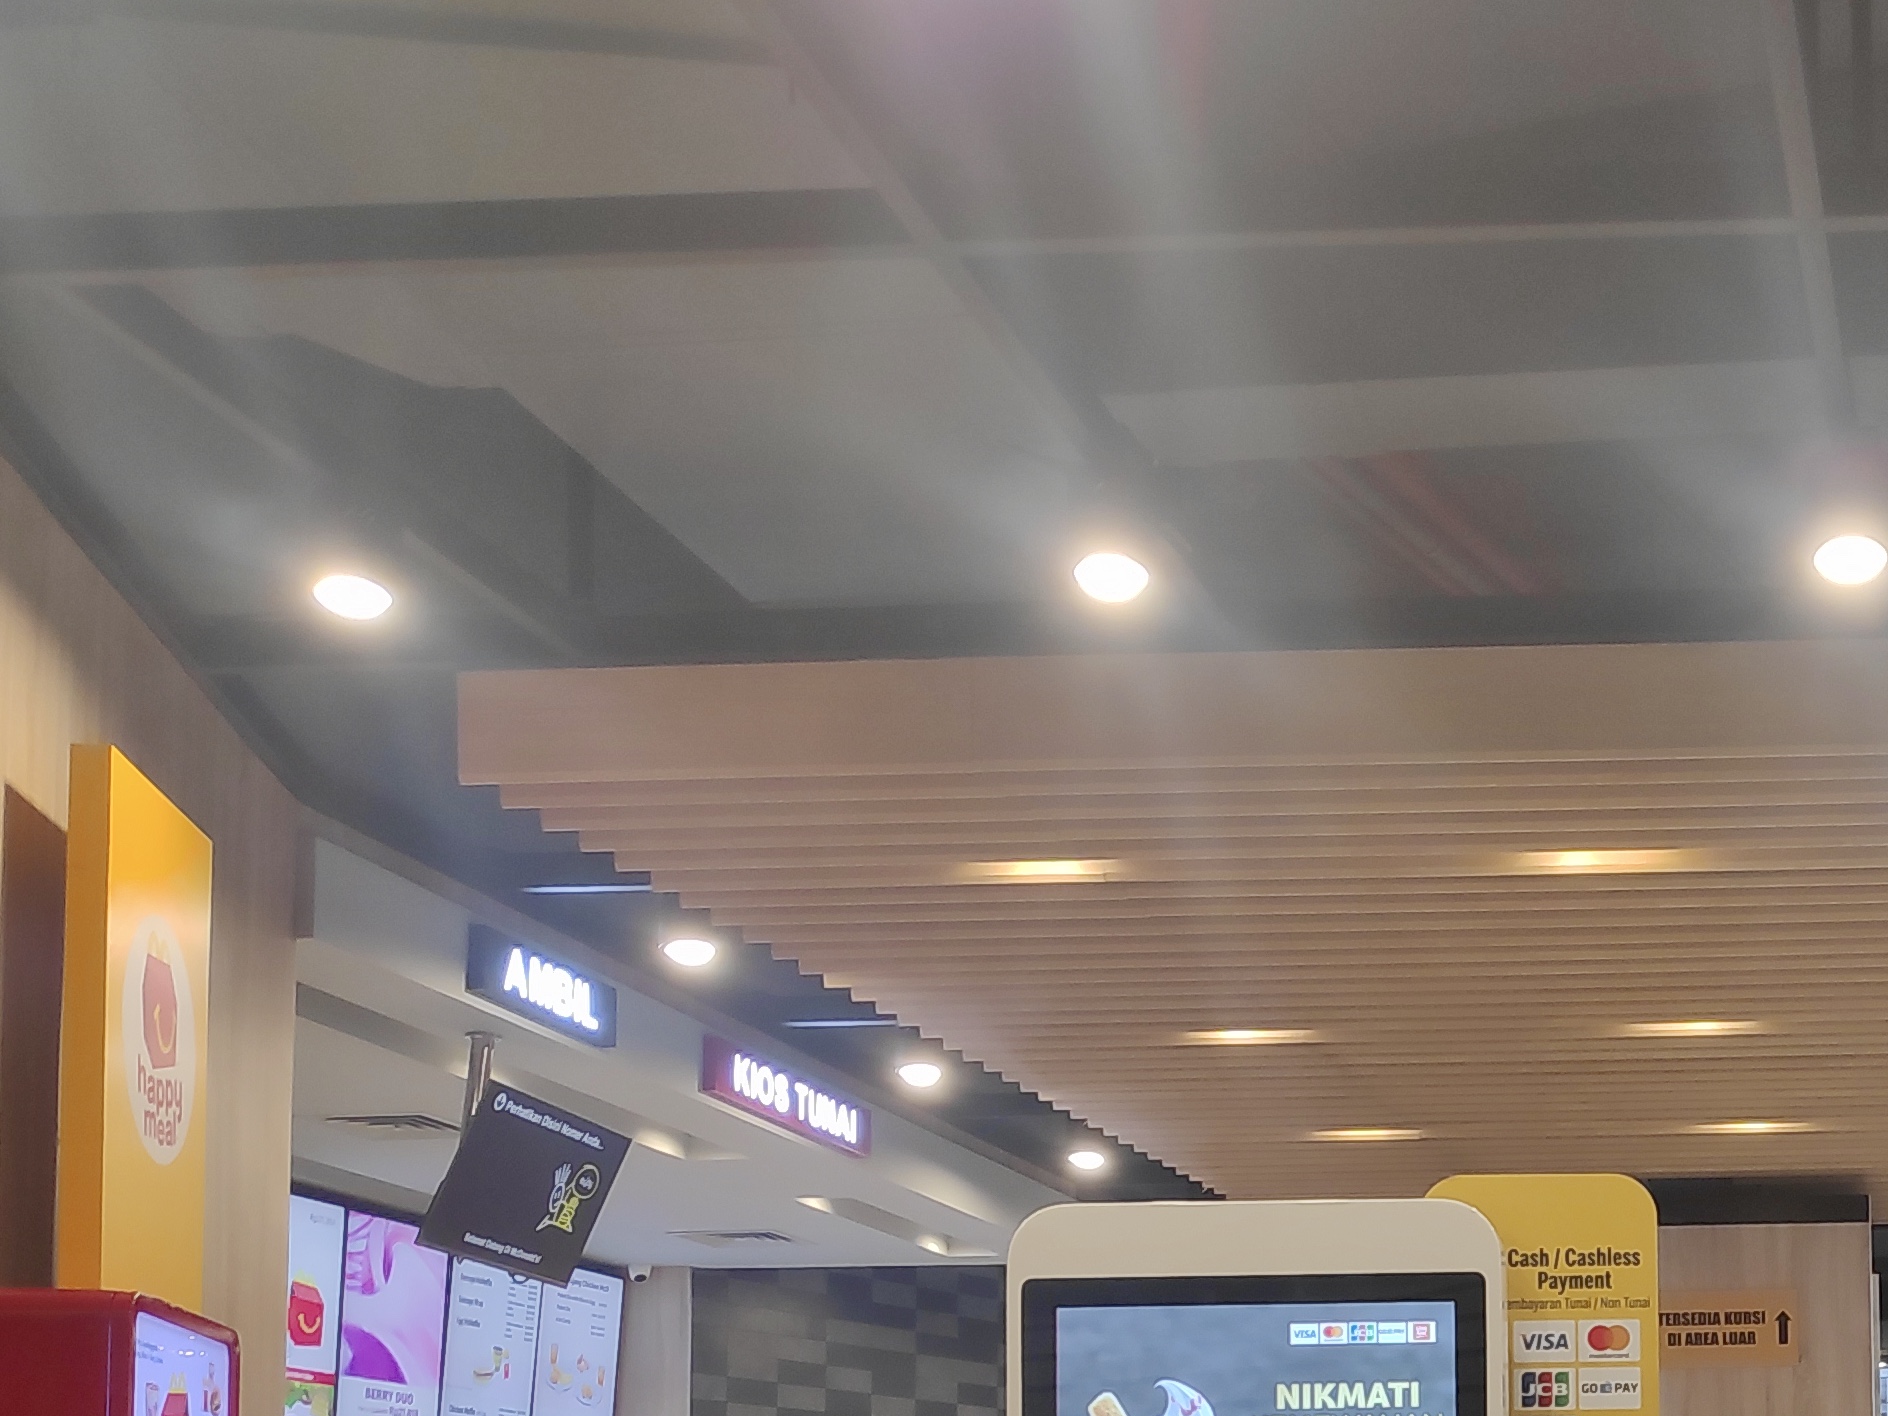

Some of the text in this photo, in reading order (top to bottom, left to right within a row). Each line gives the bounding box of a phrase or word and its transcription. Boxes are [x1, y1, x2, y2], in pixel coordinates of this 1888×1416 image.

[503, 946, 600, 1032] AMBIL
[137, 1053, 182, 1123] happy
[733, 1053, 858, 1144] KIOS TUNAI
[144, 1109, 177, 1147] meal
[1507, 1247, 1549, 1268] Cash
[1564, 1246, 1641, 1267] Cashless
[1537, 1270, 1613, 1294] Payment
[1506, 1298, 1562, 1313] embayaran
[1600, 1296, 1622, 1309] Non
[1659, 1310, 1766, 1327] TERSEDIA KURSI
[1520, 1333, 1570, 1351] VISA
[1667, 1331, 1757, 1347] DI AREA LUAR
[1276, 1381, 1420, 1410] NIKMATI
[1614, 1382, 1639, 1394] PAY
